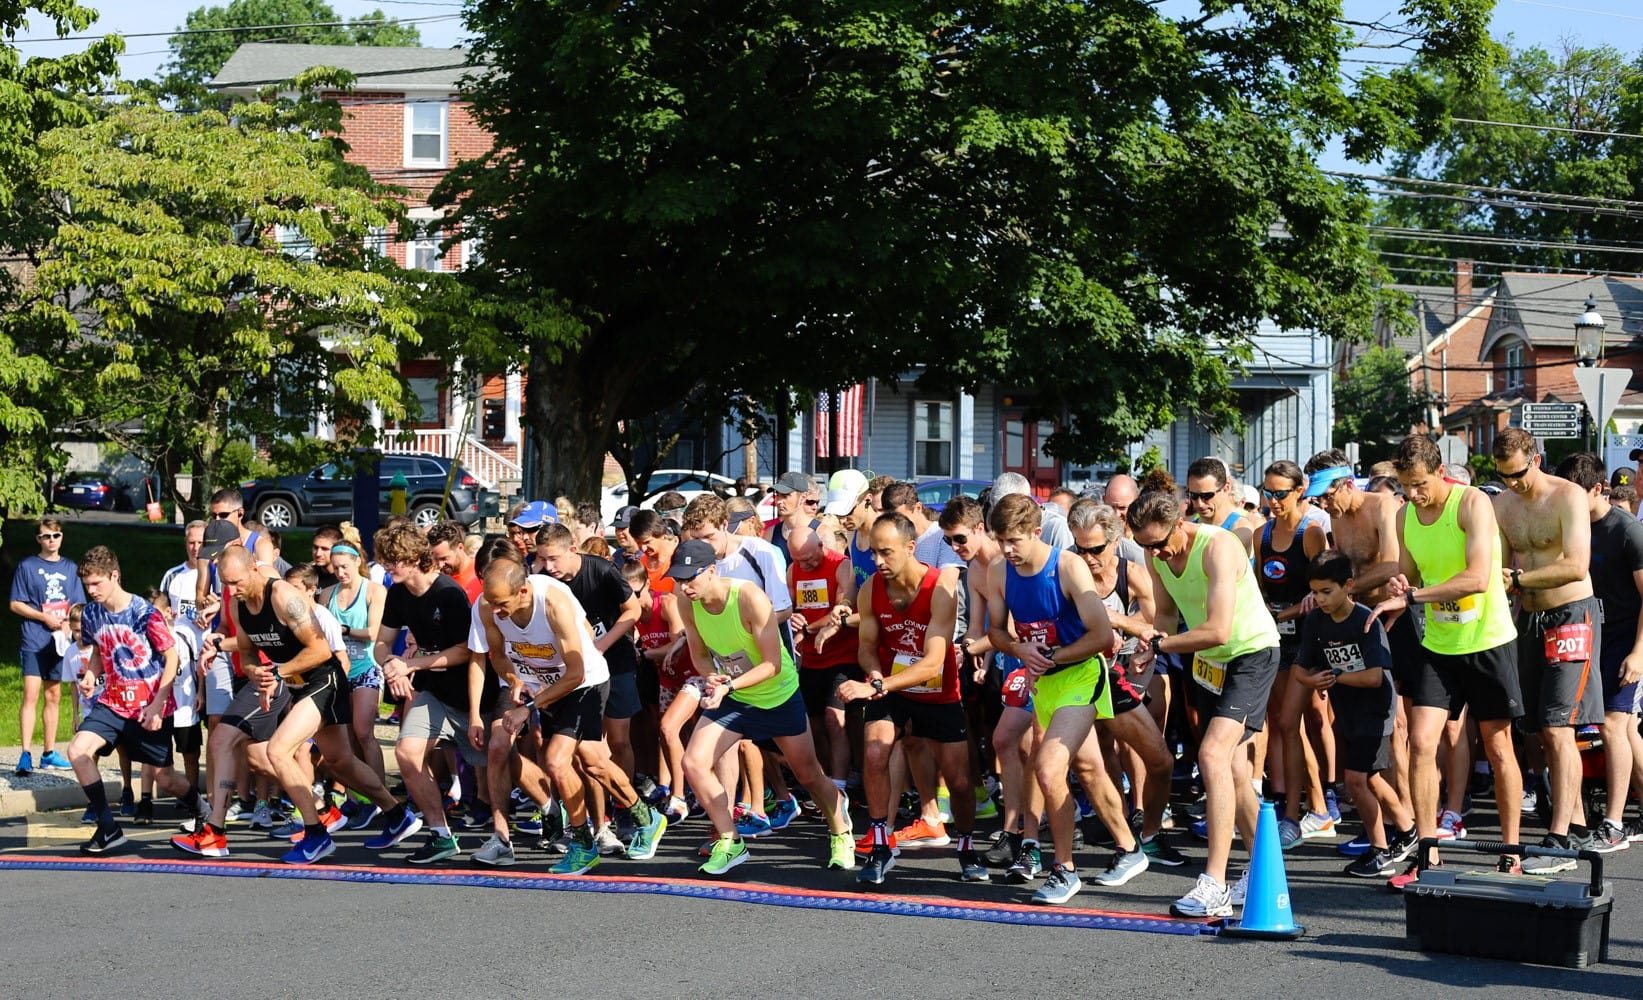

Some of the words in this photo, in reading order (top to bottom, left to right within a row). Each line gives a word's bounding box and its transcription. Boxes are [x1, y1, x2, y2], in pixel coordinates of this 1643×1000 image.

[802, 589, 818, 603] 388
[904, 620, 928, 631] COUNT
[1557, 637, 1585, 654] 207
[1326, 645, 1361, 663] 2834
[1198, 659, 1213, 682] 375
[120, 691, 134, 702] 10
